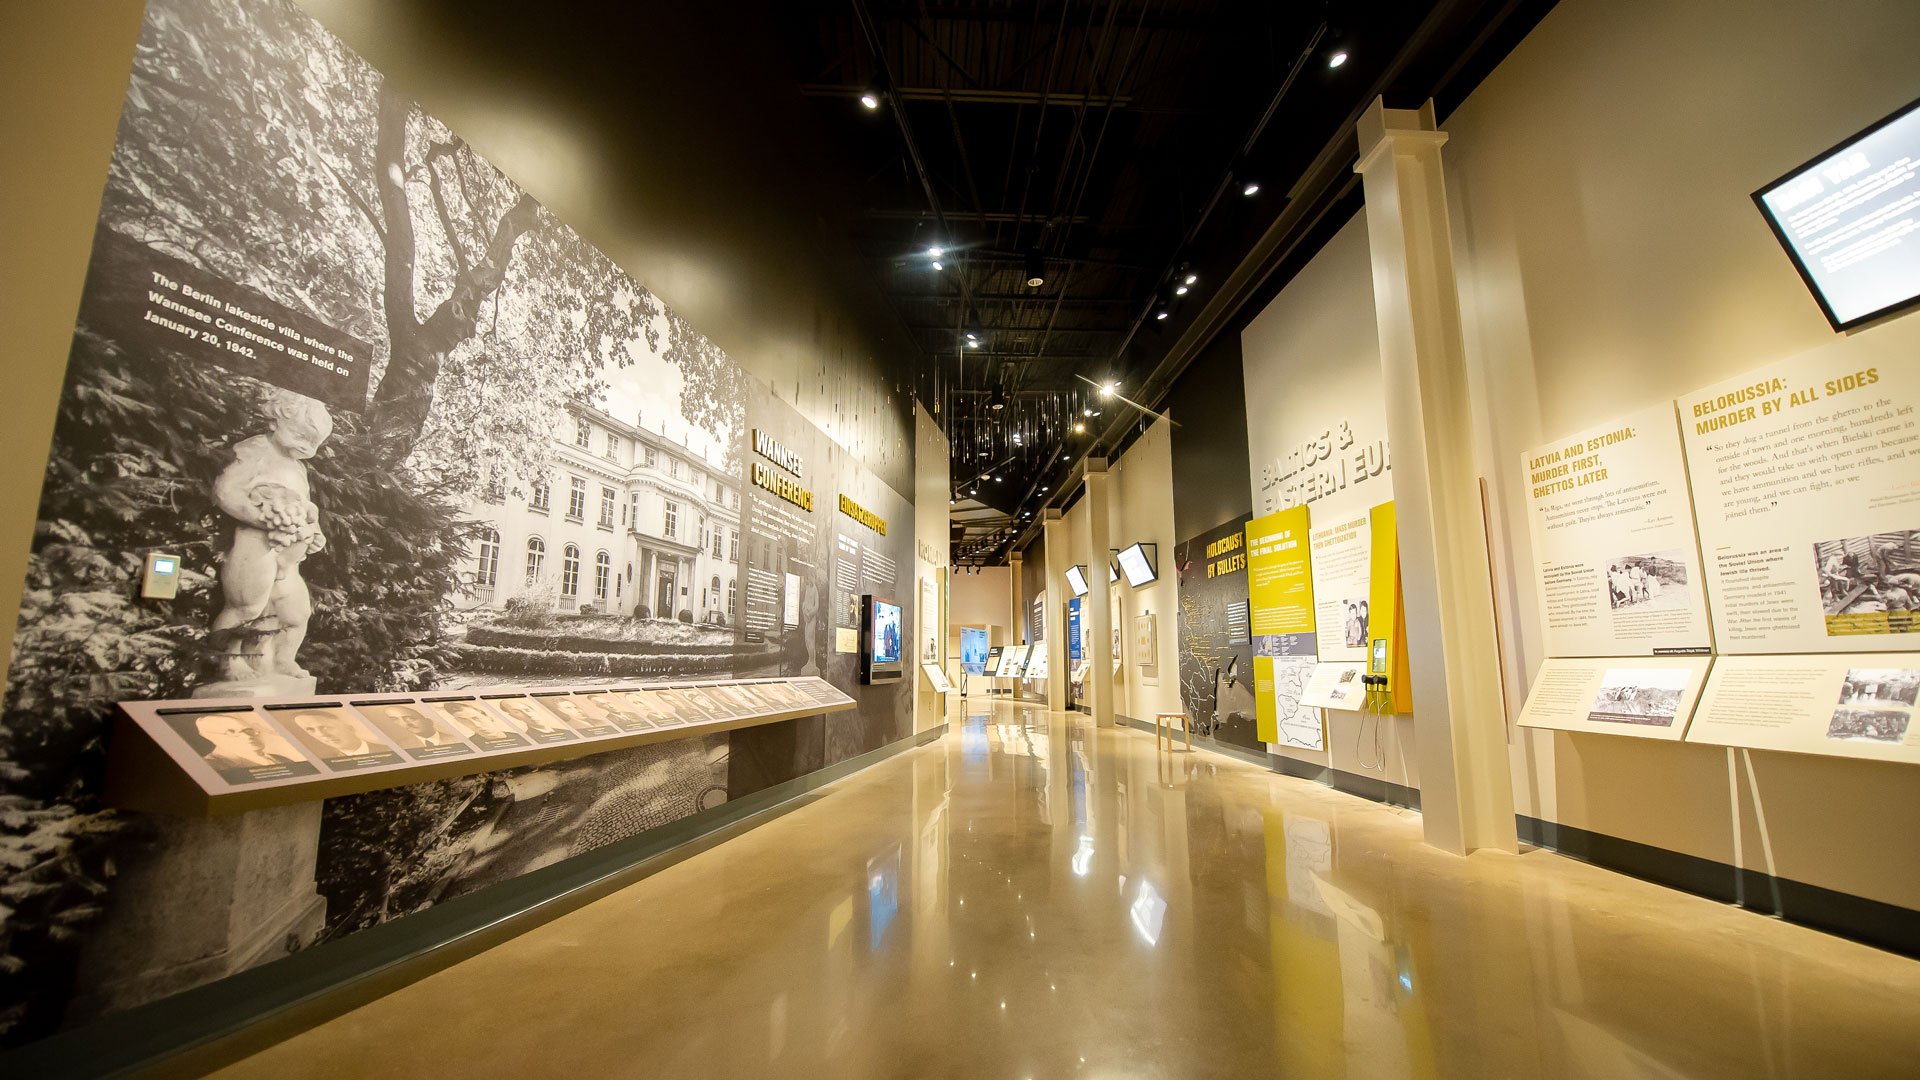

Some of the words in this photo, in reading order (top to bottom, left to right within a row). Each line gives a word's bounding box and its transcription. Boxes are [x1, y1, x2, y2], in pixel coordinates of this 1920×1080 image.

[144, 311, 198, 339] January
[201, 331, 221, 348] 20,
[226, 341, 256, 359] 1942.
[149, 290, 211, 324] Wannsee
[216, 317, 284, 351] Conference
[288, 347, 309, 361] was
[312, 355, 334, 371] held
[337, 366, 349, 377] on
[152, 271, 178, 291] The
[182, 284, 221, 309] Berlin
[225, 302, 276, 331] lakeside
[278, 325, 300, 340] villa
[304, 336, 335, 355] where
[338, 349, 353, 362] the
[1693, 377, 1787, 417] BELORUSSIA:
[1696, 407, 1756, 435] MURDER
[1762, 398, 1782, 416] BY
[1790, 387, 1819, 408] ALL
[1825, 368, 1879, 396] SIDES
[1716, 452, 1741, 463] outside
[1752, 445, 1772, 455] town
[1773, 439, 1788, 449] and
[1791, 436, 1805, 444] one
[1808, 425, 1847, 440] morning,
[1850, 412, 1894, 428] hundreds
[1897, 404, 1914, 416] left
[1726, 440, 1740, 451] they
[1743, 435, 1757, 445] dug
[1765, 426, 1790, 438] tunnel
[1792, 421, 1813, 431] from
[1816, 415, 1829, 424] the
[1832, 407, 1861, 423] ghetto
[1876, 397, 1892, 407] the
[753, 429, 803, 478] WANNSEE
[1262, 431, 1331, 491] BALTICS
[1340, 420, 1354, 450] &
[1530, 451, 1561, 470] LATVIA
[1564, 444, 1583, 459] AND
[1587, 427, 1636, 452] ESTONIA:
[1531, 464, 1569, 485] MURDER
[1572, 454, 1603, 473] FIRST,
[1718, 466, 1728, 475] for
[1730, 462, 1741, 471] the
[1744, 456, 1768, 468] woods.
[1772, 451, 1789, 461] And
[1792, 445, 1814, 456] that's
[1816, 439, 1839, 450] when
[1842, 430, 1873, 444] Bielski
[1876, 425, 1901, 436] came
[1904, 420, 1915, 428] in
[1720, 476, 1732, 485] and
[1734, 473, 1750, 484] they
[1752, 466, 1776, 478] would
[1778, 462, 1795, 472] take
[1808, 453, 1828, 465] with
[1831, 449, 1852, 462] open
[1855, 443, 1879, 454] arms
[1881, 433, 1919, 448] because
[752, 462, 814, 512] CONFERENCE
[1533, 477, 1574, 499] GHETTOS
[1578, 468, 1608, 487] LATER
[1733, 485, 1750, 495] have
[1752, 474, 1799, 490] ammunition
[1802, 469, 1817, 479] and
[1835, 462, 1855, 472] have
[1858, 456, 1884, 468] rifles,
[1887, 450, 1906, 461] and
[1736, 497, 1761, 507] young,
[1763, 491, 1778, 500] and
[1810, 479, 1833, 492] fight,
[839, 493, 887, 536] EINSATZGRUPPEN
[1348, 517, 1366, 529] MURDER
[1724, 508, 1747, 521] joined
[1207, 532, 1243, 559] HOLOCAUST
[1208, 563, 1215, 578] BY
[1217, 553, 1246, 576] BULLETS
[1260, 546, 1272, 555] FINAL
[1274, 540, 1297, 552] SOLUTION
